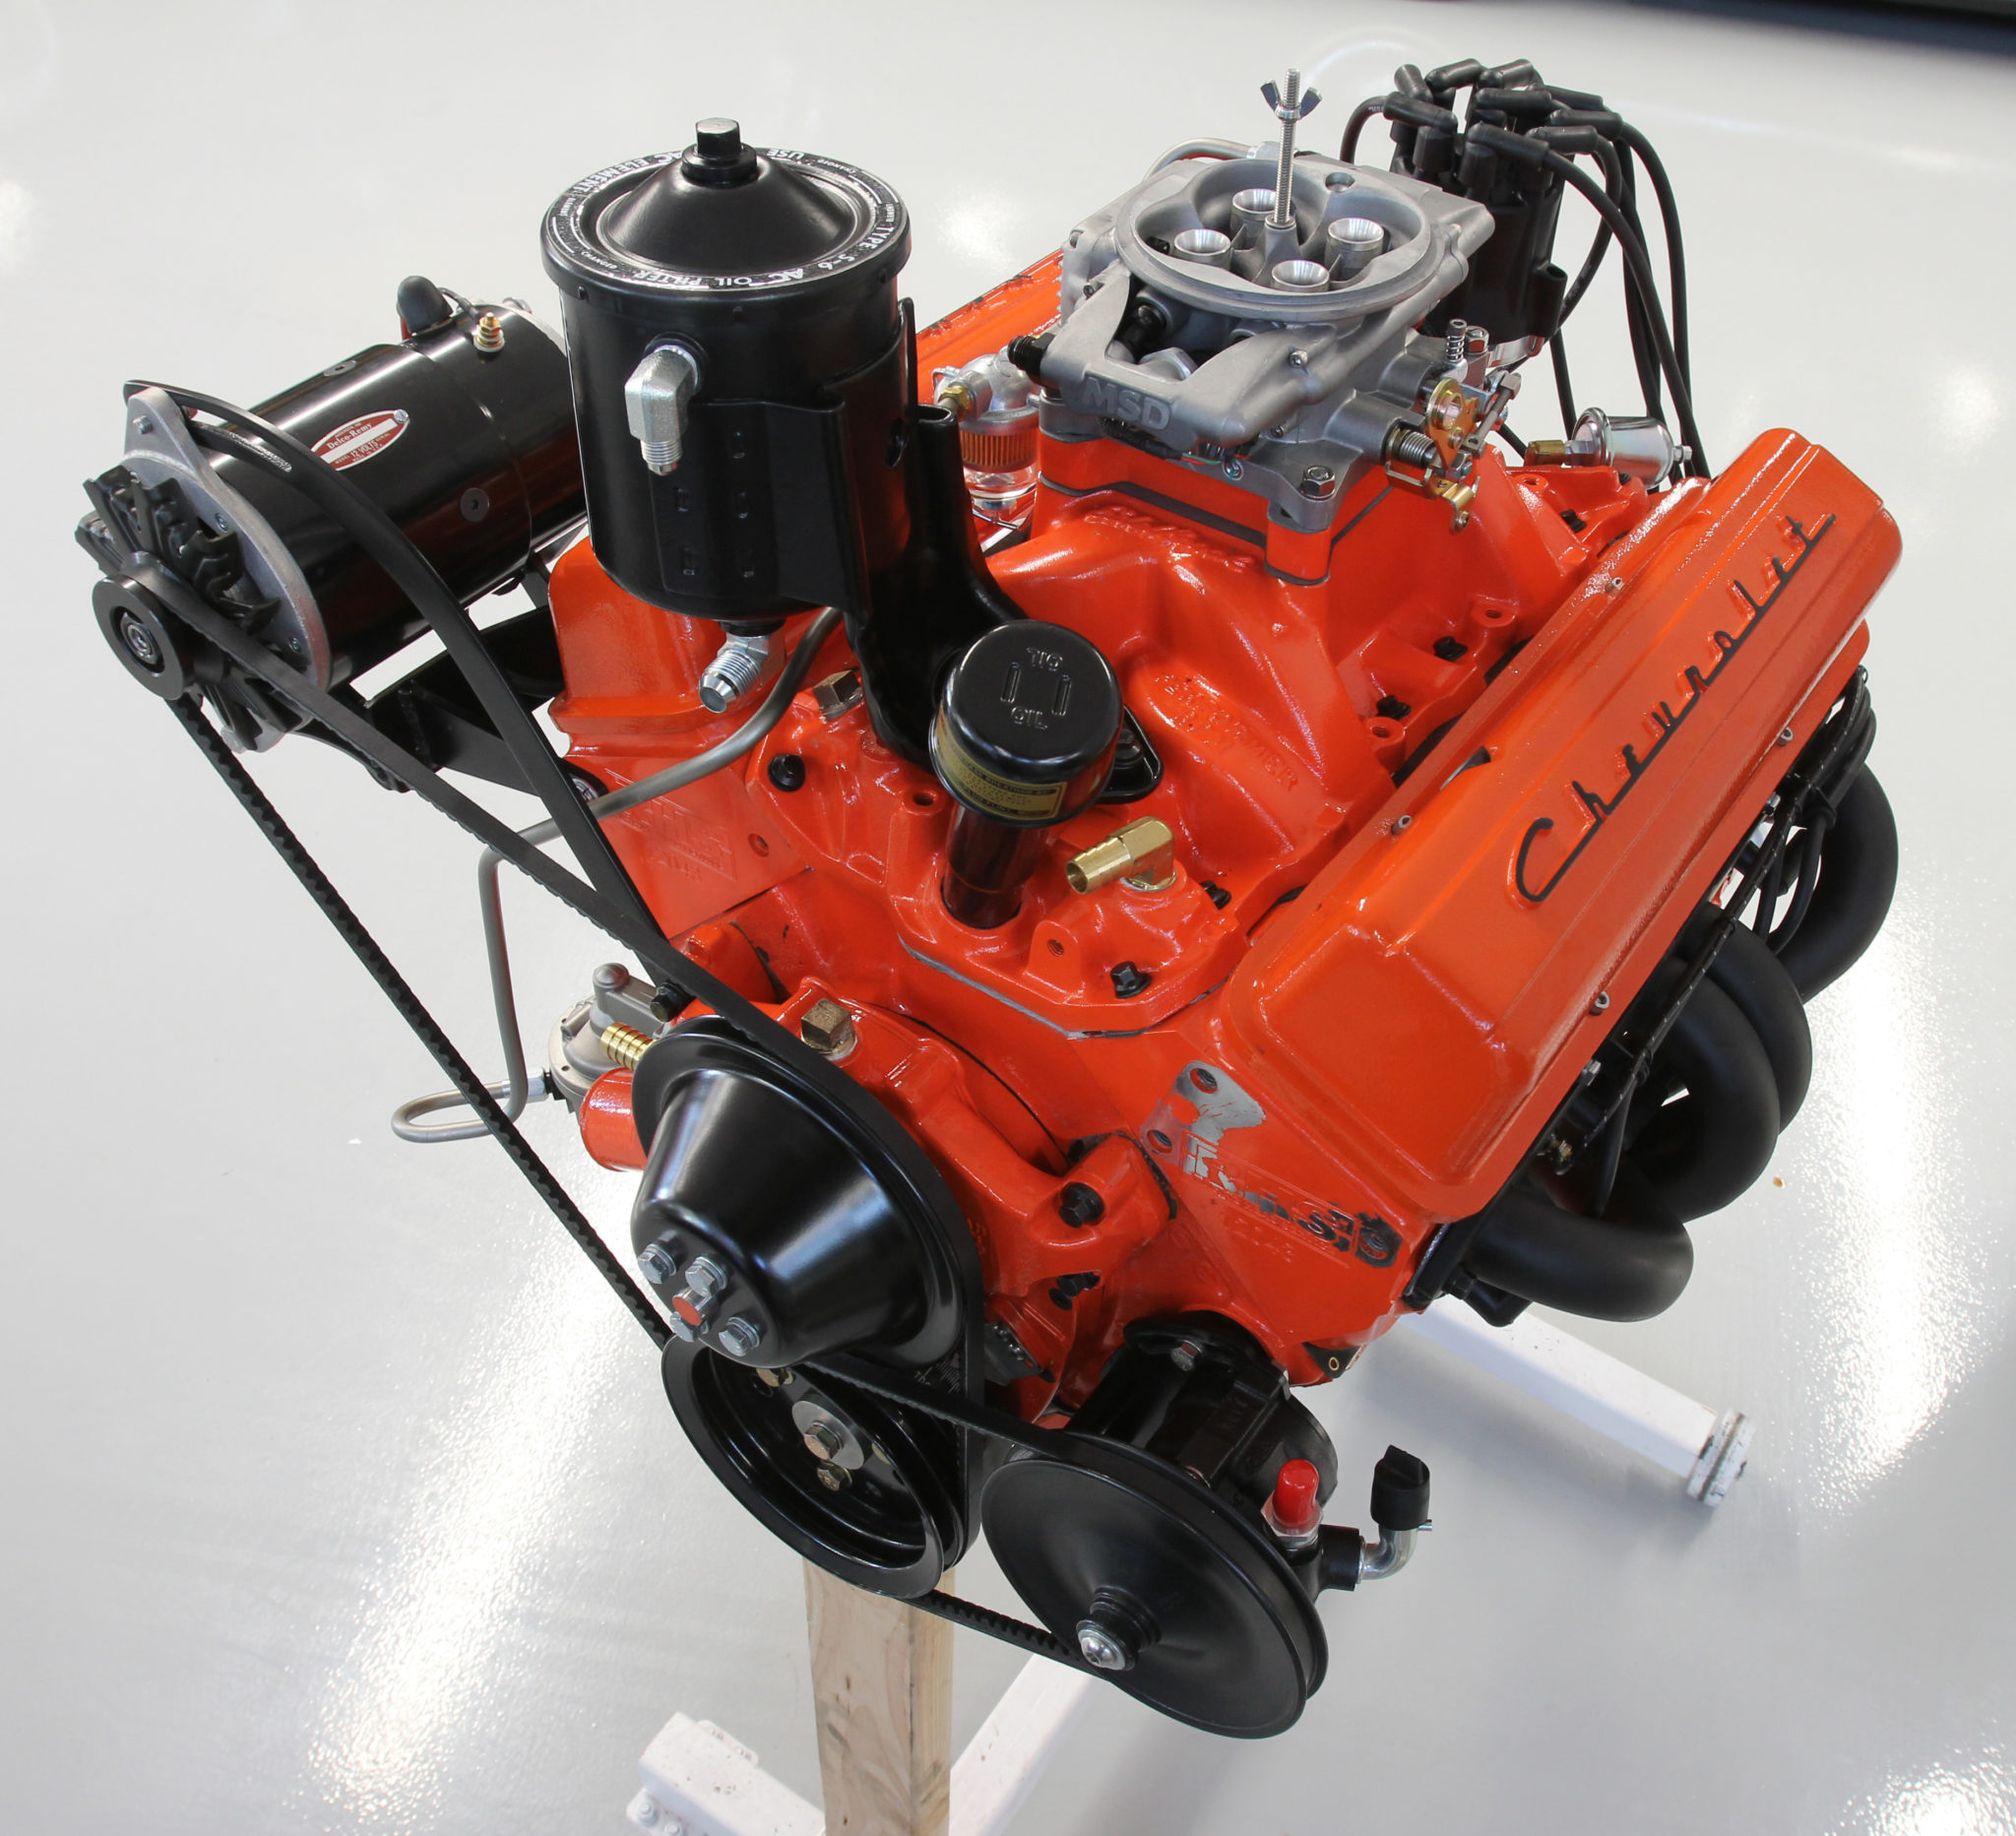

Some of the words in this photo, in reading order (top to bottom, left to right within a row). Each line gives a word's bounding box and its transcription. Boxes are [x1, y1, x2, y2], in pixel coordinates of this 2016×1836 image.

[767, 149, 805, 159] USE
[573, 158, 650, 192] ELEMENT
[858, 226, 895, 249] TYPE
[817, 253, 855, 271] S-6
[715, 277, 753, 286] OIL
[768, 268, 804, 285] AC
[1084, 376, 1171, 430] MSD
[326, 422, 373, 450] Delco-Remy
[349, 450, 361, 459] 12
[358, 440, 379, 454] VOLTS
[1514, 512, 1837, 902] Chevrolet
